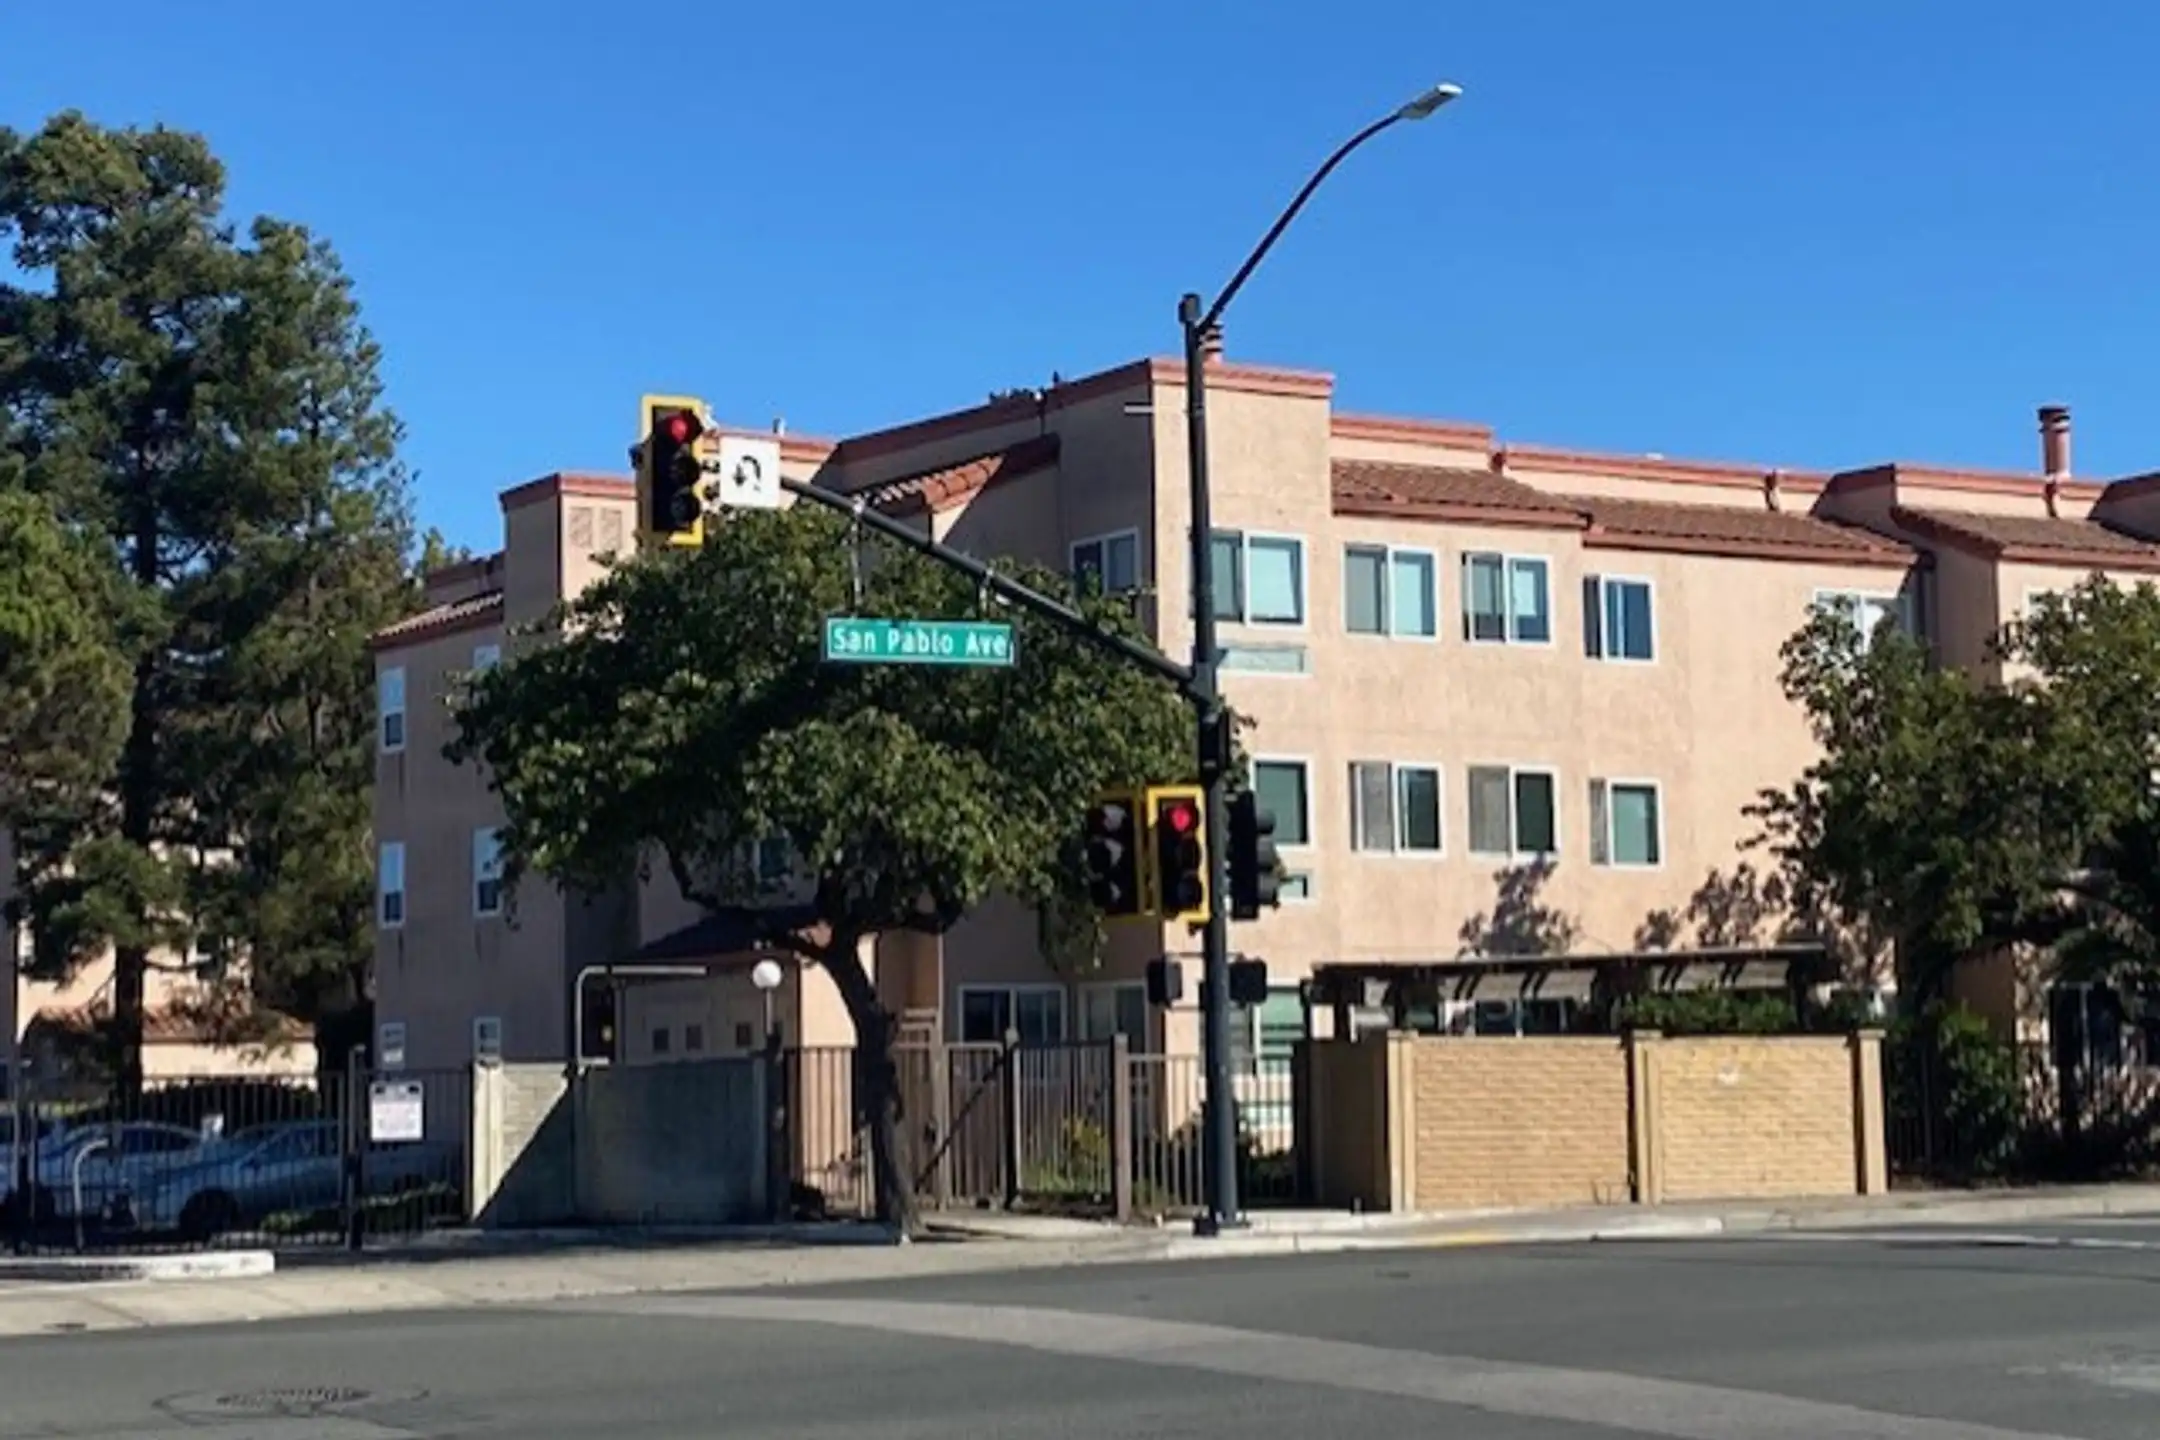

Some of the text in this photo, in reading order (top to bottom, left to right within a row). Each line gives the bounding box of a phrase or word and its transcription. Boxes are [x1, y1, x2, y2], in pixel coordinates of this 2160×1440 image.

[833, 625, 1007, 657] San Pablo Ave
